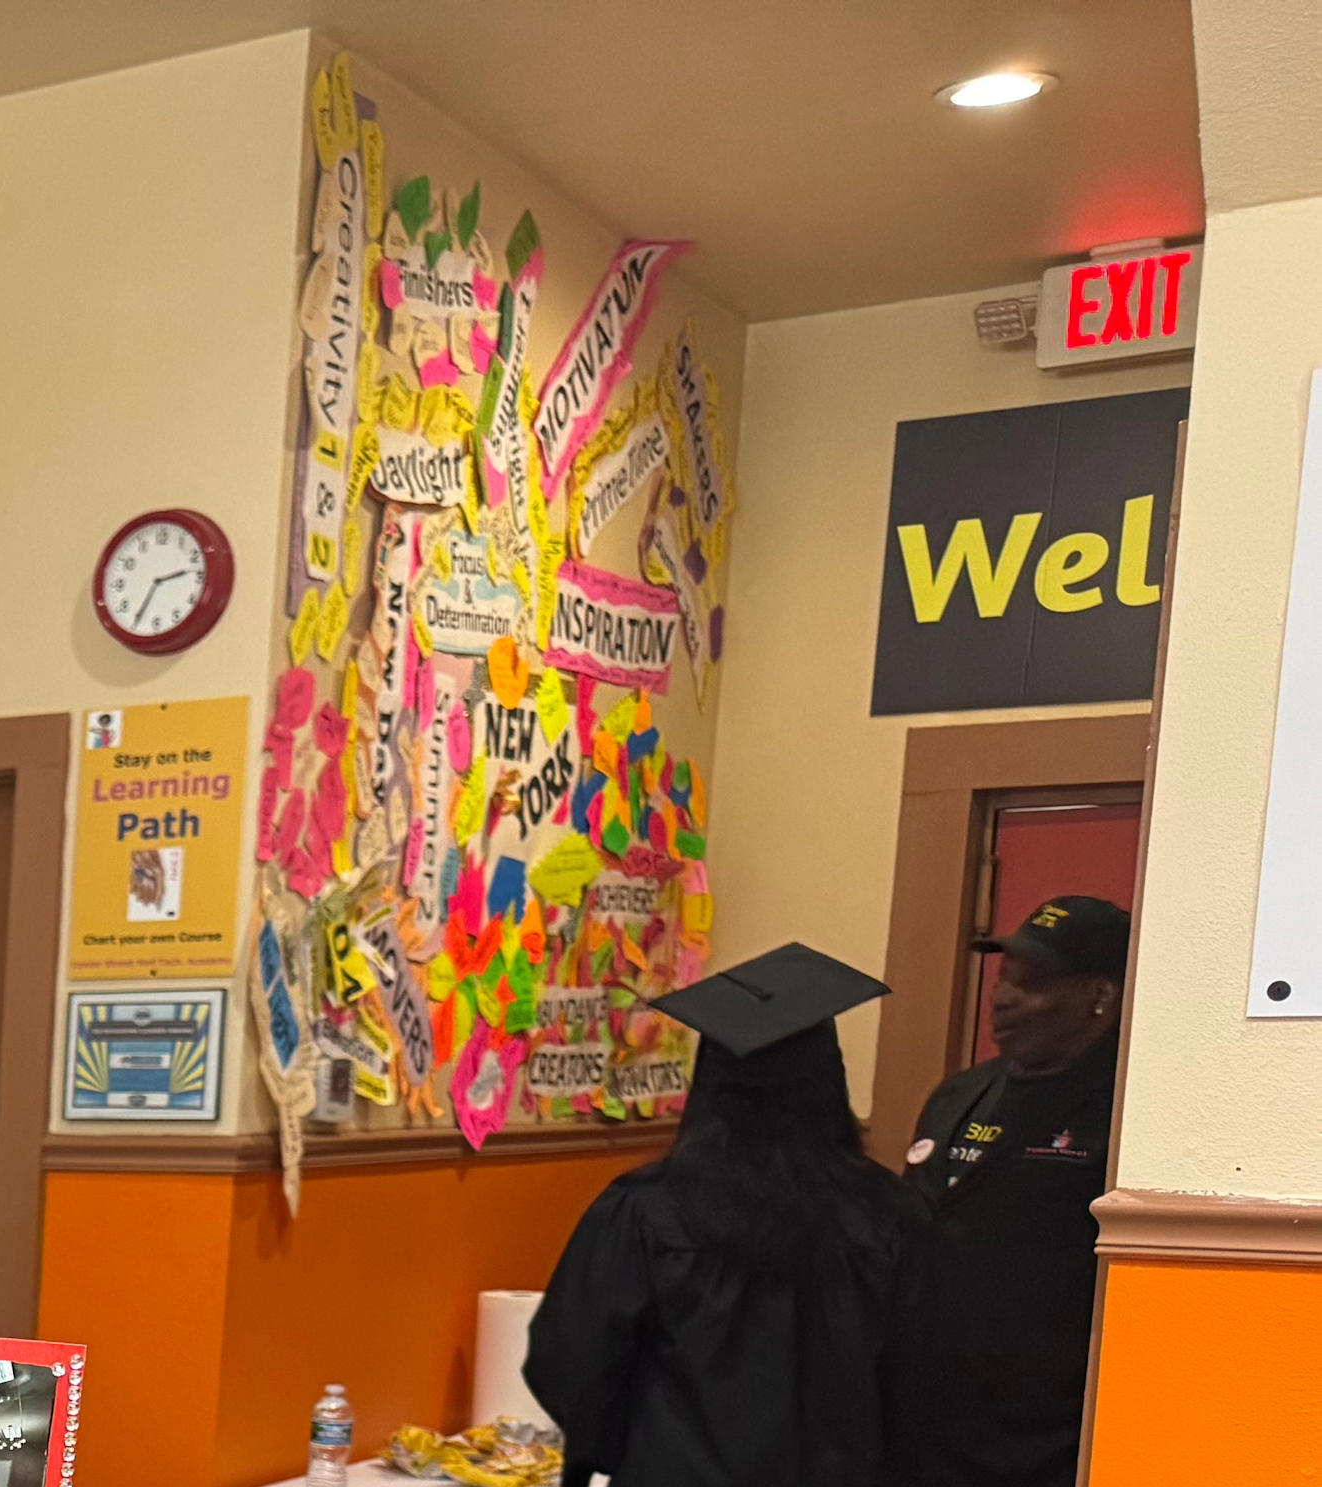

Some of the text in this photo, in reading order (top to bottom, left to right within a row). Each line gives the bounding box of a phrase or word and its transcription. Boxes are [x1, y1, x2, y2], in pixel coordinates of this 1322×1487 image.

[318, 157, 357, 426] Creativity
[1065, 252, 1193, 350] EXIT
[896, 493, 1161, 624] Wel
[114, 748, 213, 770] Stay on the
[485, 702, 537, 763] NEW
[92, 770, 231, 804] Learning
[116, 808, 201, 842] Path
